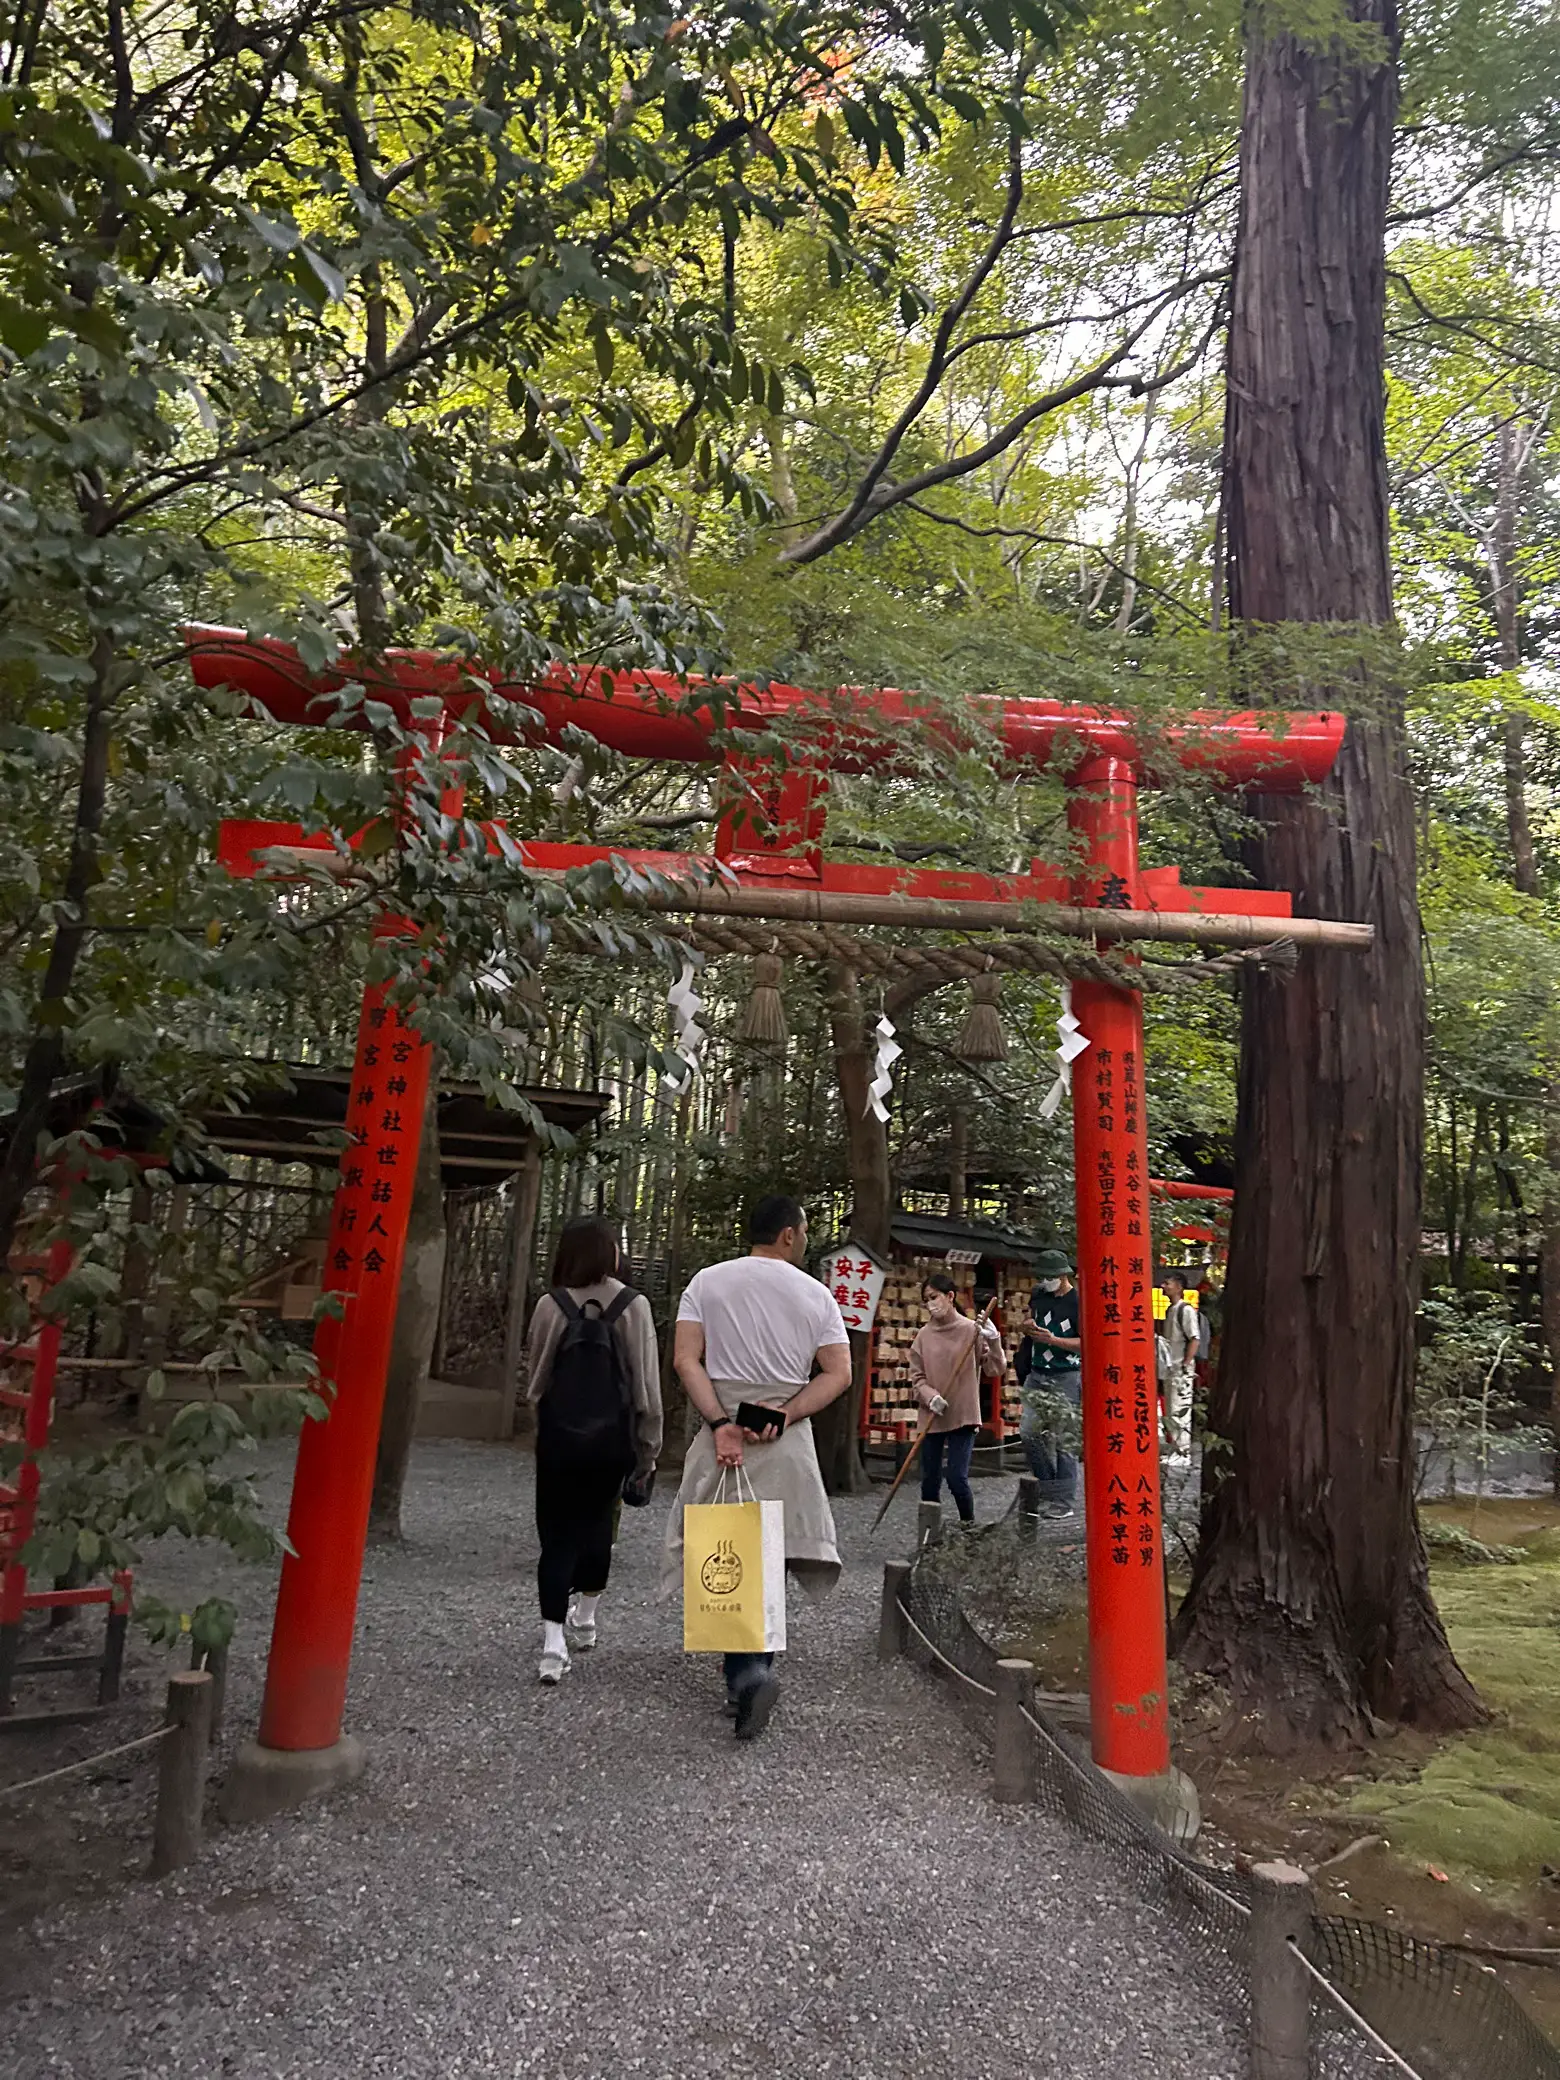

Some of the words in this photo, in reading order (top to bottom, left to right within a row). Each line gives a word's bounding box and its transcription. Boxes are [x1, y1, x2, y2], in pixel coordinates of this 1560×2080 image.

[834, 1255, 854, 1306] 安産
[852, 1260, 874, 1310] 子宝
[1127, 1256, 1147, 1344] 瀬戸正二
[1107, 1473, 1131, 1566] 八木早苗
[1136, 1473, 1155, 1567] 八木治男
